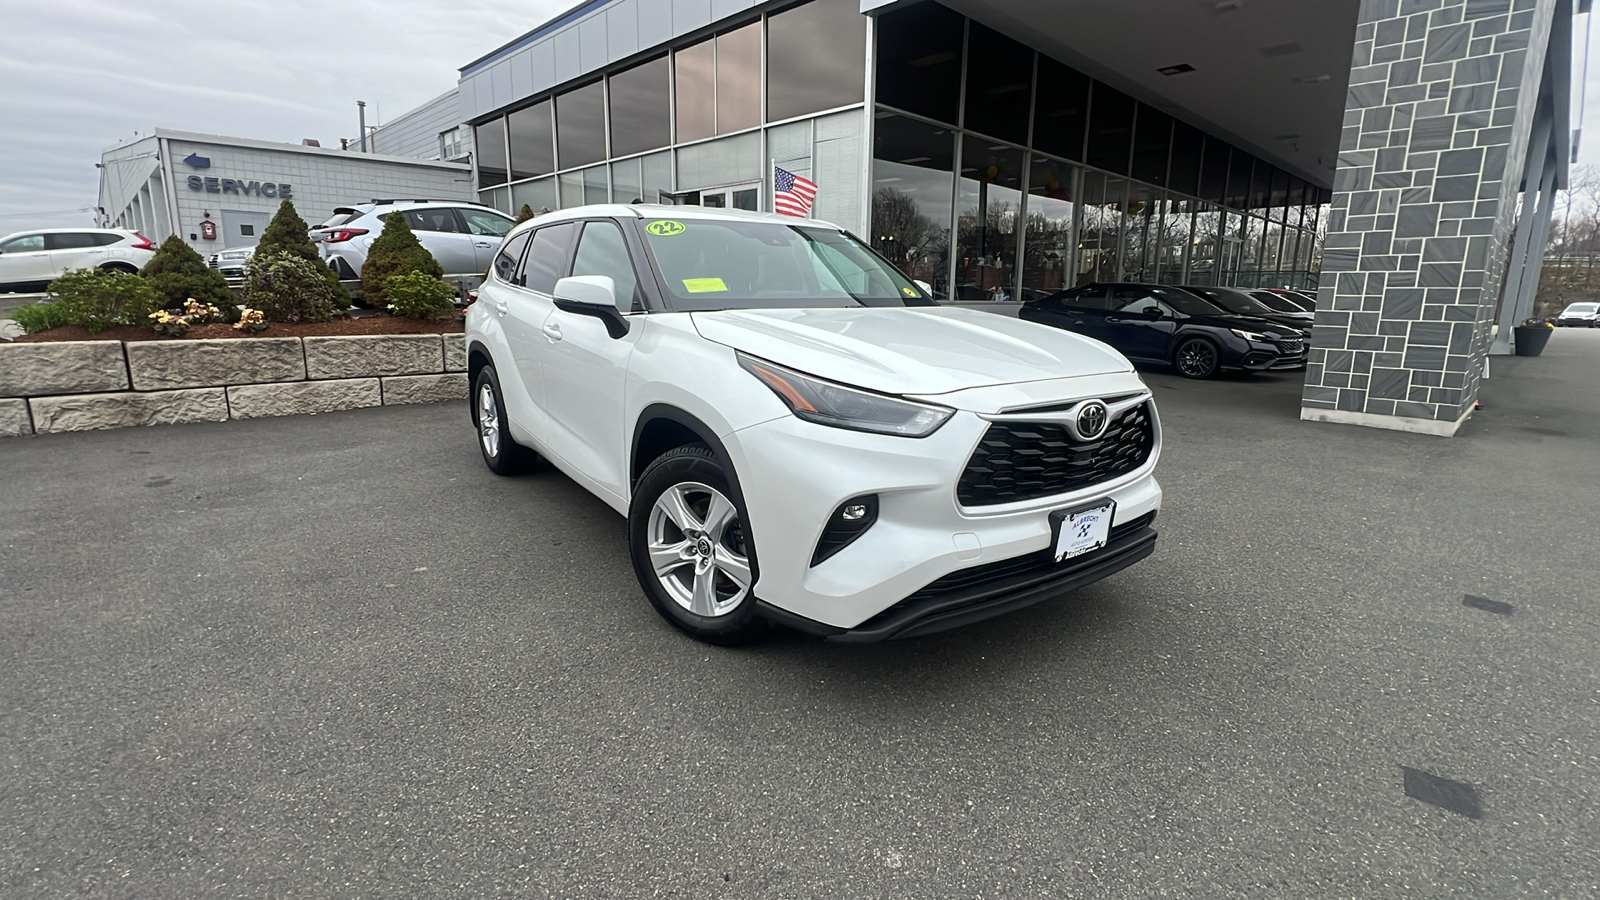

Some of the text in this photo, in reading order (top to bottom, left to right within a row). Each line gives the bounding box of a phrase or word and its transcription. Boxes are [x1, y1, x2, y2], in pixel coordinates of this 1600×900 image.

[187, 175, 293, 199] SERVICE
[653, 221, 680, 235] 22
[1072, 515, 1099, 530] ALBRECHT
